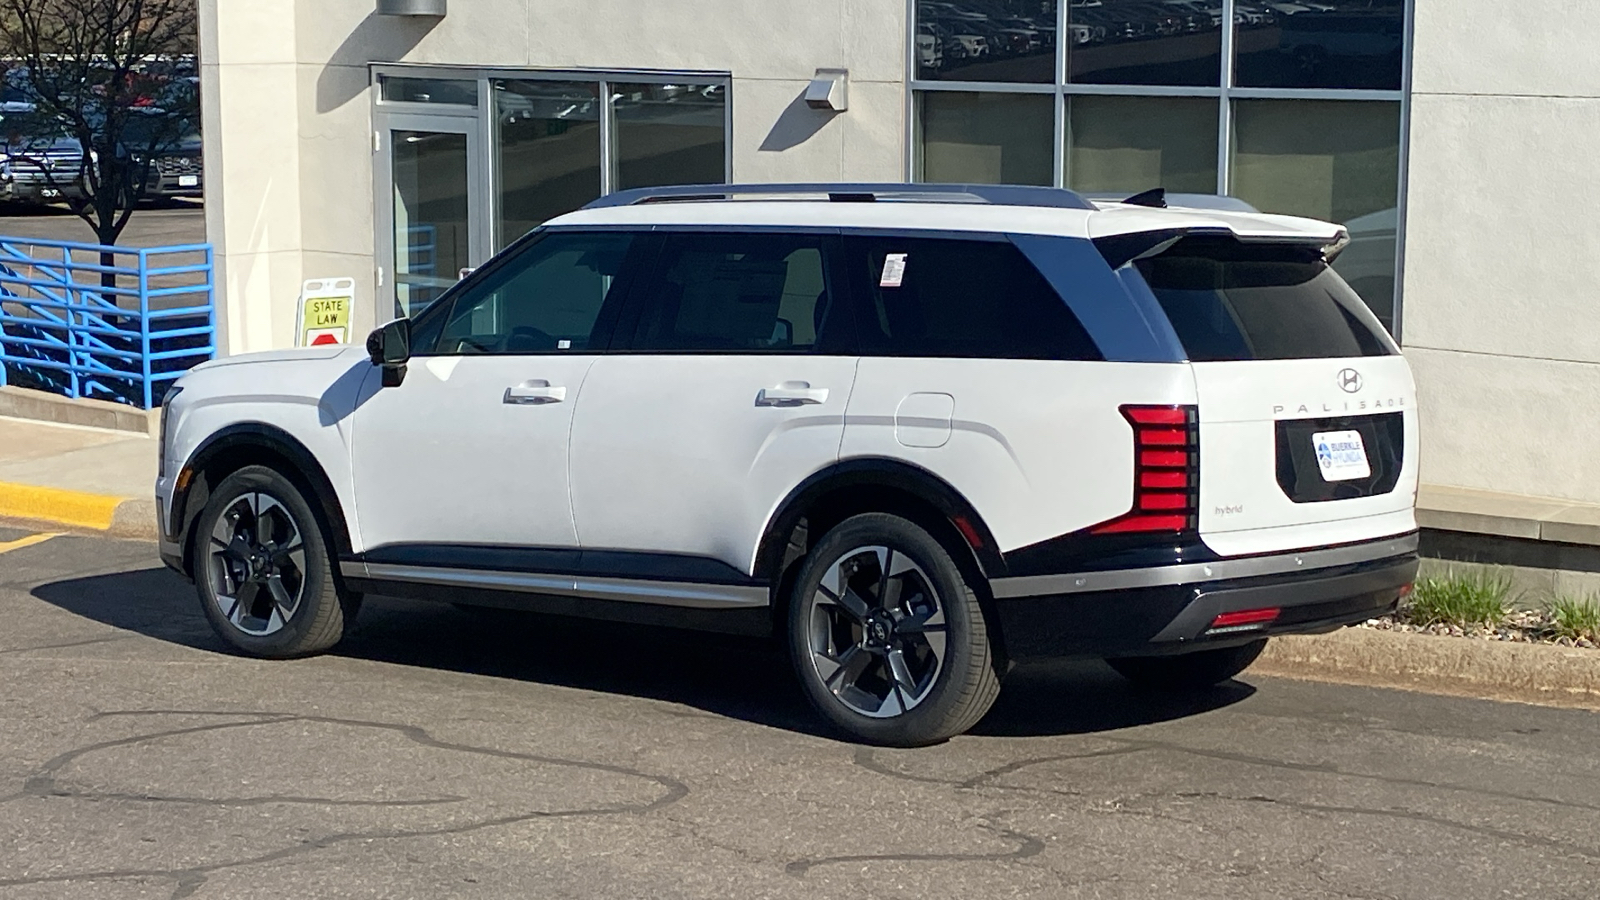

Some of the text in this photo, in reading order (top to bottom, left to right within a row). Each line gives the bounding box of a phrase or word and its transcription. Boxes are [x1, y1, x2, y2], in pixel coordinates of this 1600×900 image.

[313, 300, 342, 313] STATE
[317, 314, 338, 325] LAW
[1273, 397, 1404, 414] PALISADE
[1330, 441, 1361, 452] BUERKLE
[1215, 504, 1243, 517] hybrid
